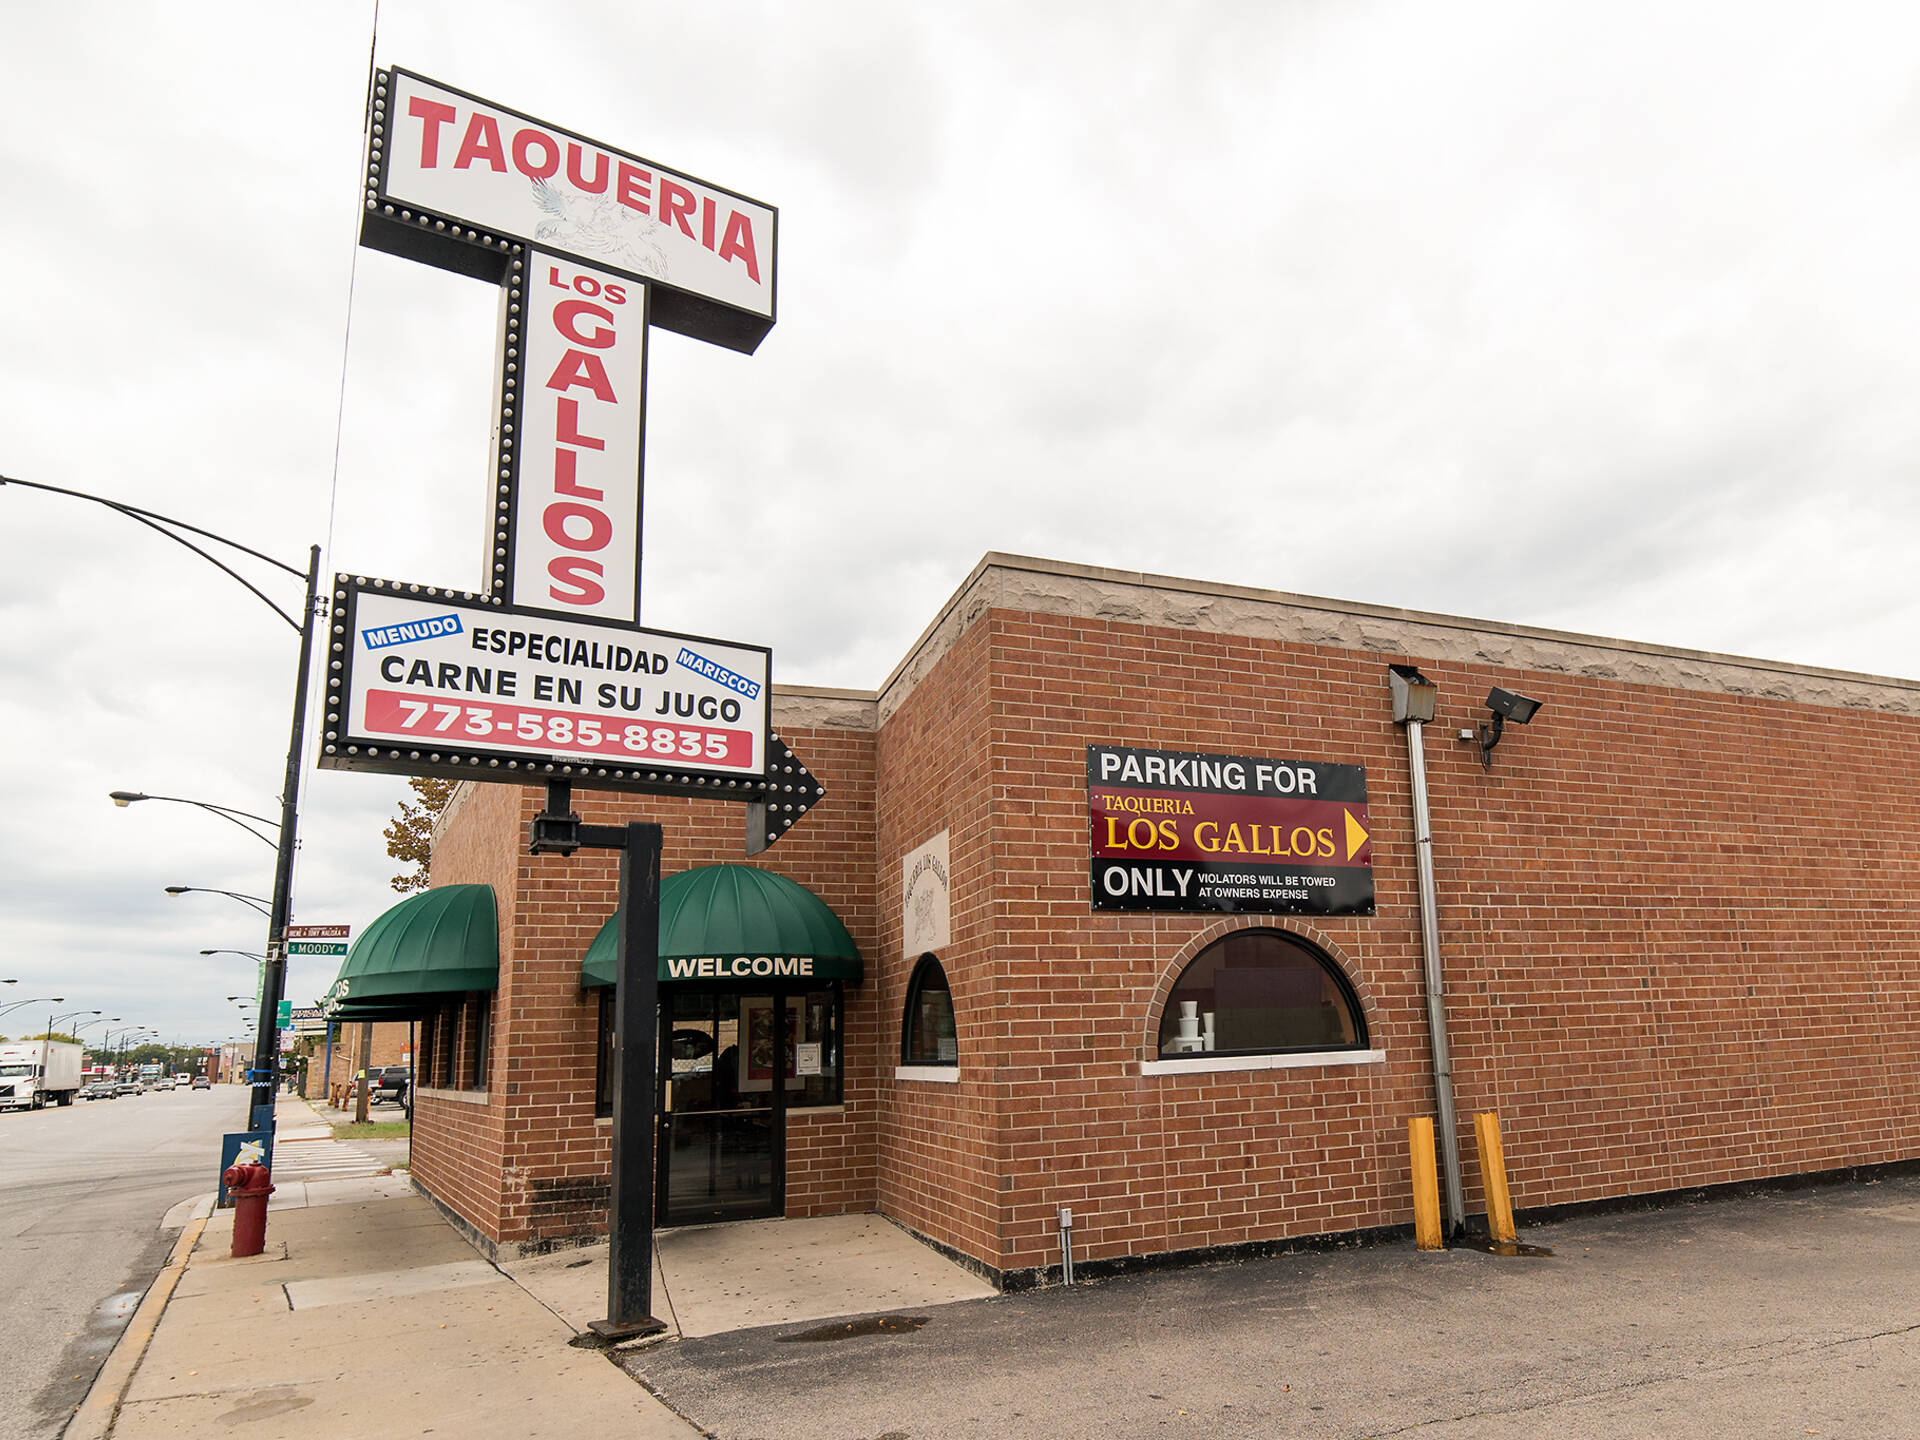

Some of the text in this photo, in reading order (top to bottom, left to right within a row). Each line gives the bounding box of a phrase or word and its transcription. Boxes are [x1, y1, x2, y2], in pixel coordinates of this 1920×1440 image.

[408, 95, 761, 286] TAQUERIA
[549, 266, 627, 305] LOS
[543, 299, 618, 606] GALLOS
[367, 616, 459, 649] MENUDO
[471, 627, 669, 676] ESPECIALIDAD
[380, 655, 742, 723] CARNE EN SU JUGO
[677, 650, 760, 699] MARISCOS
[400, 700, 729, 760] 773-585-8835
[1100, 752, 1318, 795] PARKING FOR
[1102, 795, 1196, 817] TAQUERIA
[1104, 816, 1336, 858] LOS GALLOS
[1103, 866, 1194, 897] ONLY
[1198, 872, 1336, 887] VIOLATORS WILL BE TOWED
[1199, 887, 1309, 900] AT OWNERS EXPENSE
[298, 943, 336, 954] MOODY
[667, 957, 814, 979] WELCOME
